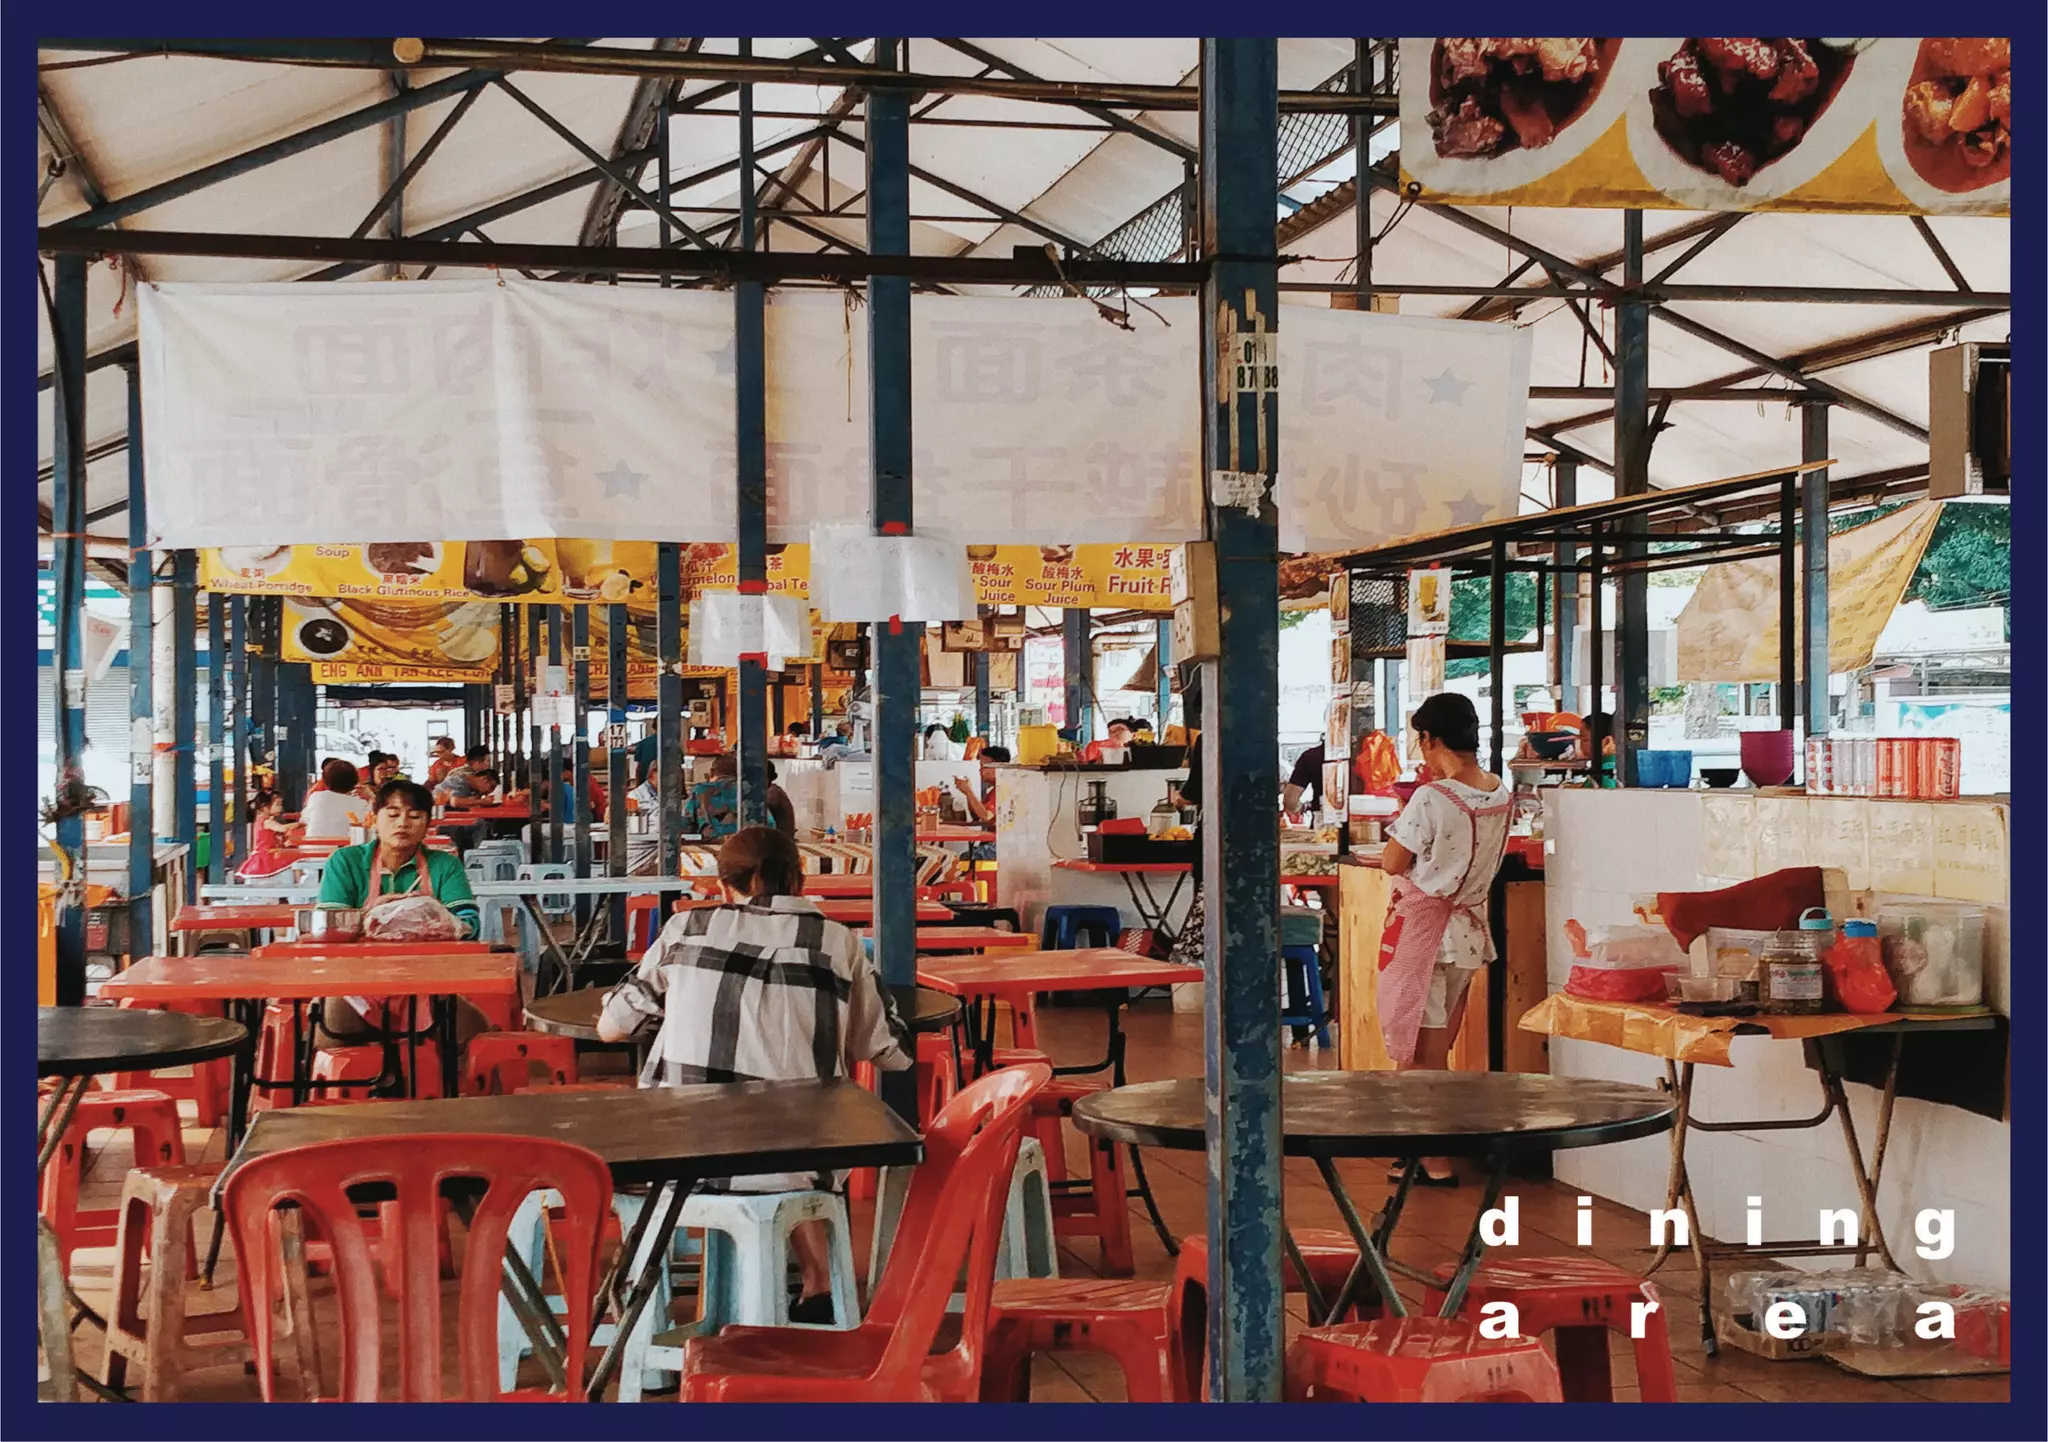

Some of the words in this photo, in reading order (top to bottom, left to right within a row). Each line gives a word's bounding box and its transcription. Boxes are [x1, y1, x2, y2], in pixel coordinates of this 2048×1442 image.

[315, 546, 350, 558] Soup
[969, 562, 1015, 577] 酸梅水
[1042, 565, 1084, 580] 酸梅水
[211, 578, 253, 589] Wheat
[257, 580, 313, 594] Porridge
[790, 577, 808, 590] Te
[980, 576, 1012, 588] Sour
[1025, 578, 1058, 591] Sour
[1061, 580, 1095, 592] Plum
[1108, 575, 1155, 594] Fruit
[338, 584, 372, 595] Black
[377, 585, 439, 597] Glutinous
[444, 588, 470, 598] Rice
[980, 589, 1016, 602] Juice
[1043, 592, 1079, 605] Juice
[321, 664, 347, 678] ENG
[356, 664, 383, 678] ANN
